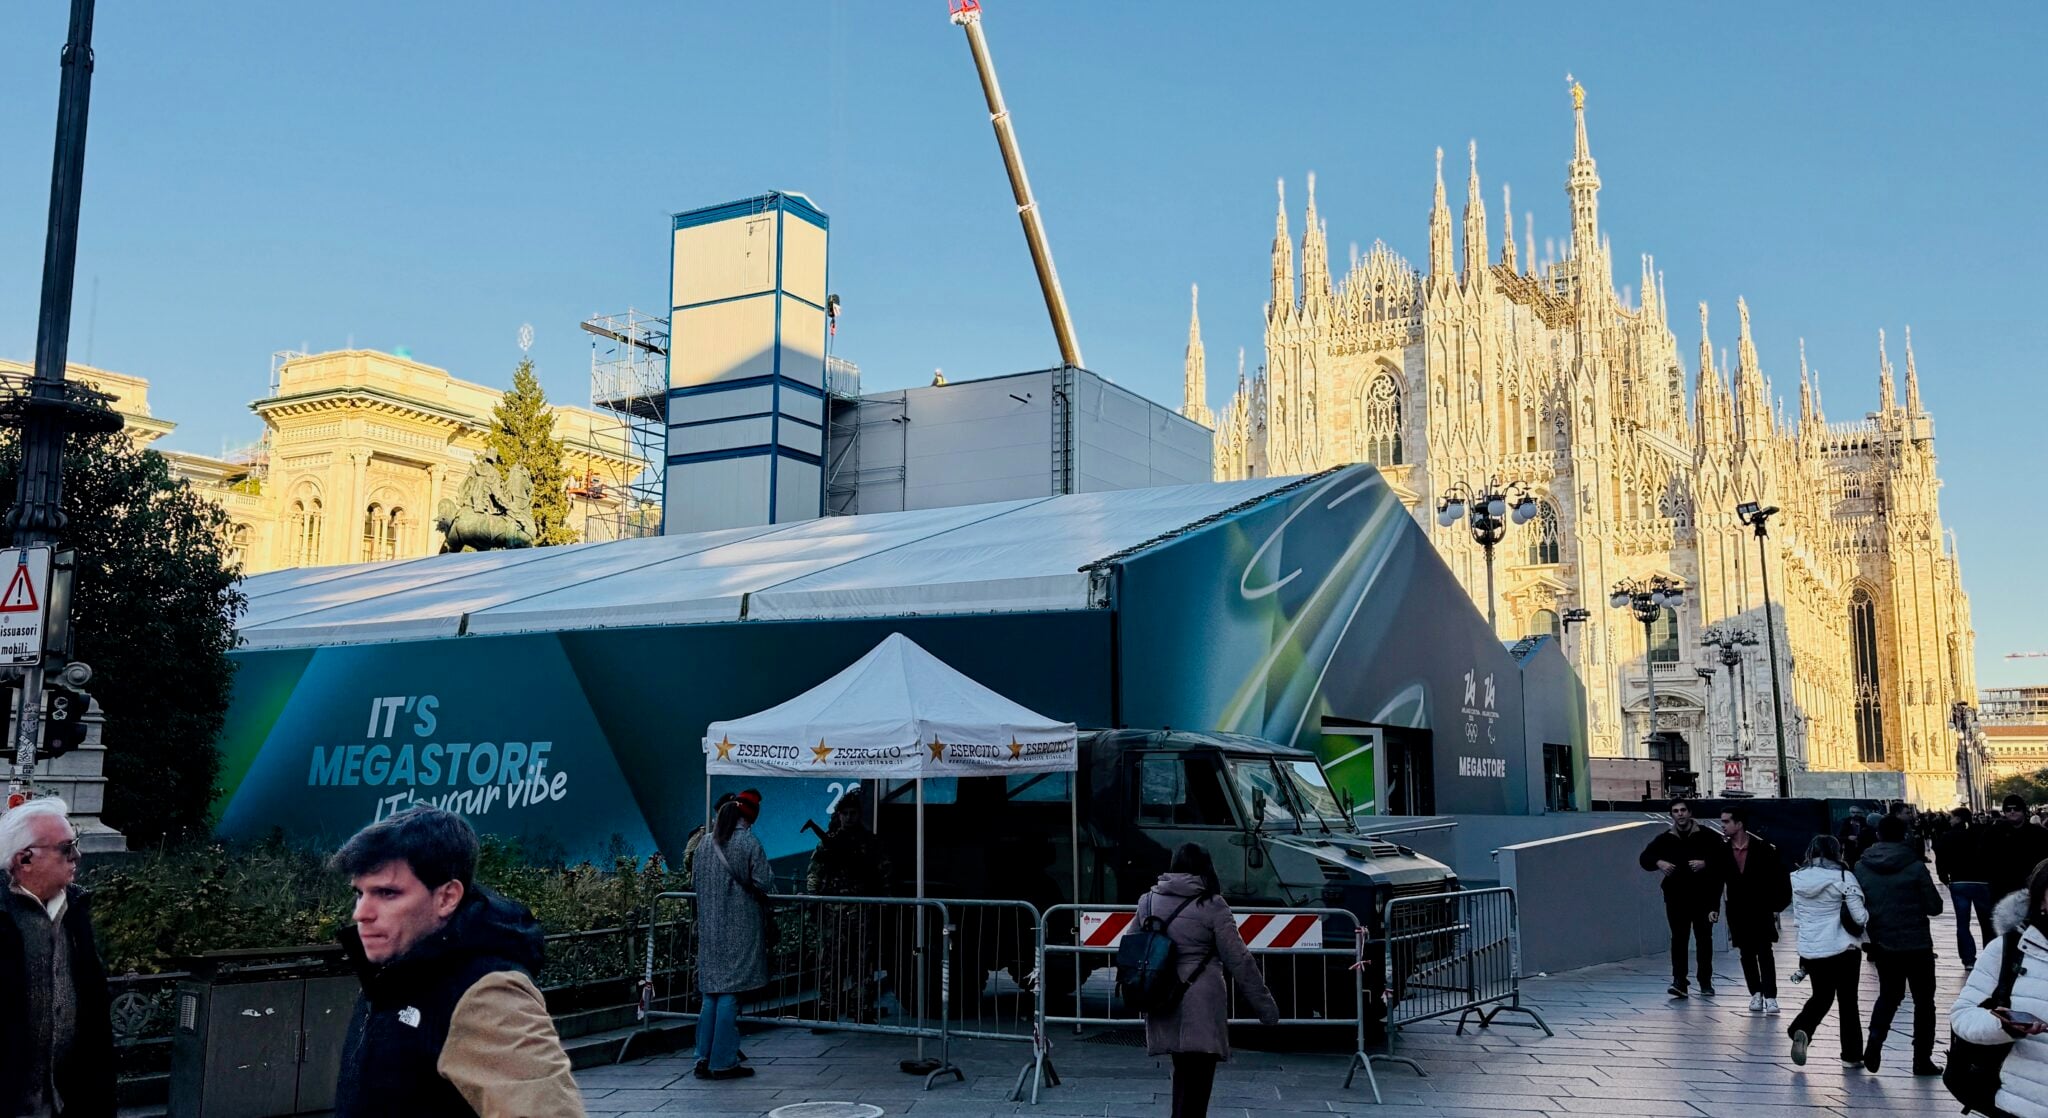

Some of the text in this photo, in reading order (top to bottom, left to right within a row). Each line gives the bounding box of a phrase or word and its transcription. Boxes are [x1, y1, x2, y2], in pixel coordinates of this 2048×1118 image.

[0, 624, 37, 637] issuasori
[1, 642, 28, 655] mobili
[366, 695, 440, 739] IT'S
[737, 743, 800, 759] ESERCITO
[834, 746, 901, 759] ESERCITO
[949, 743, 1000, 758] ESERCITO
[1025, 740, 1068, 756] ESERCITO
[307, 741, 553, 786] MEGASTORE
[1459, 756, 1506, 778] MEGASTORE
[374, 788, 425, 824] IT'
[507, 760, 568, 809] vibe
